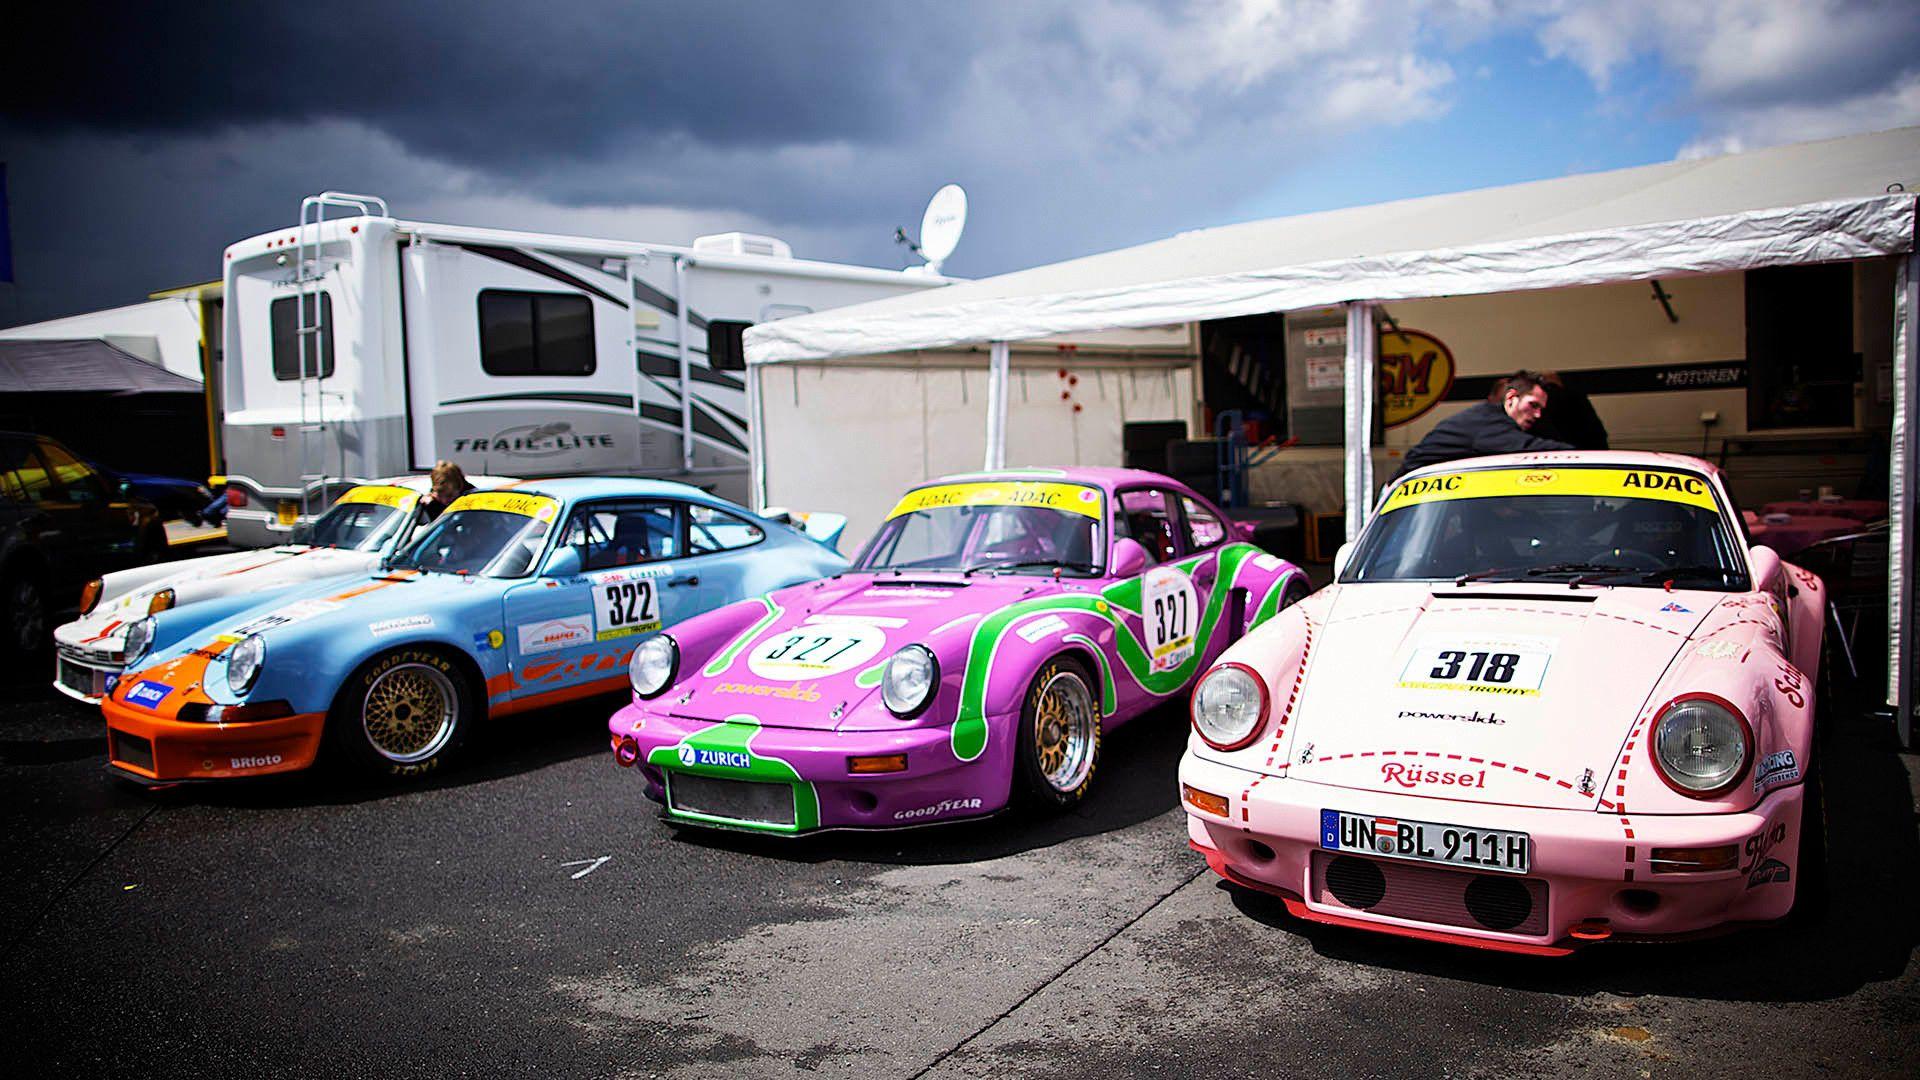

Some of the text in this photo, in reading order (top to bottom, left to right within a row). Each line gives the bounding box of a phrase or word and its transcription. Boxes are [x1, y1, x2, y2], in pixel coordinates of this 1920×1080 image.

[1665, 367, 1741, 385] MOTOREN
[453, 434, 615, 452] TRAIL-LITE
[1397, 472, 1704, 498] ADAC ADAC
[918, 489, 1062, 507] ADAC ADAC
[605, 581, 654, 627] 322
[1154, 589, 1188, 645] 327
[766, 635, 862, 664] 327
[1429, 650, 1521, 684] 318
[712, 680, 822, 703] powerslide
[1468, 684, 1528, 696] TROPHY
[1397, 710, 1506, 726] powerslide
[231, 755, 282, 769] BRfoto
[700, 750, 751, 767] ZURICH
[1380, 762, 1486, 789] Rüssel
[894, 798, 982, 820] GOODYEAR
[1340, 816, 1377, 850] UN
[1397, 823, 1435, 858] BL
